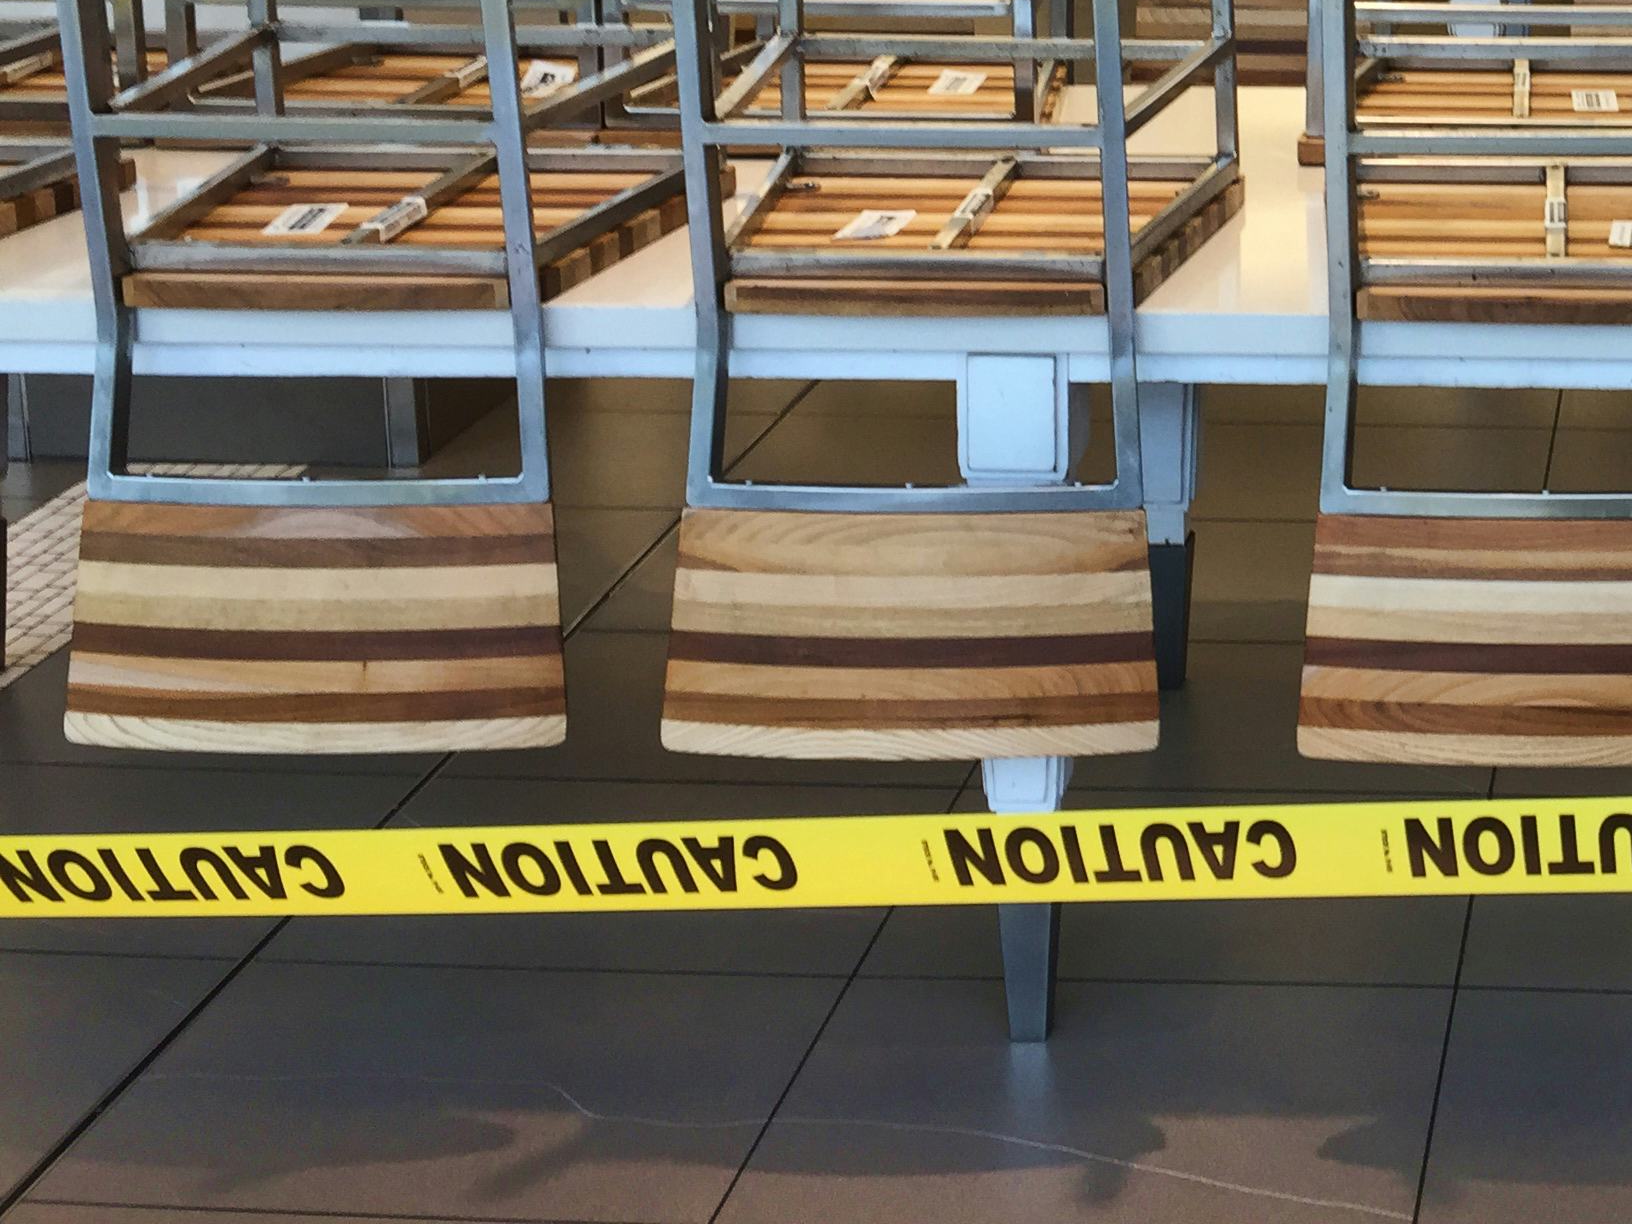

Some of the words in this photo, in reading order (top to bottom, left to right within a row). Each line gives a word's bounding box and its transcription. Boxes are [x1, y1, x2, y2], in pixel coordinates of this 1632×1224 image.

[0, 845, 346, 903] CAUTION
[437, 835, 799, 898] CAUTION
[942, 819, 1298, 886] CAUTION
